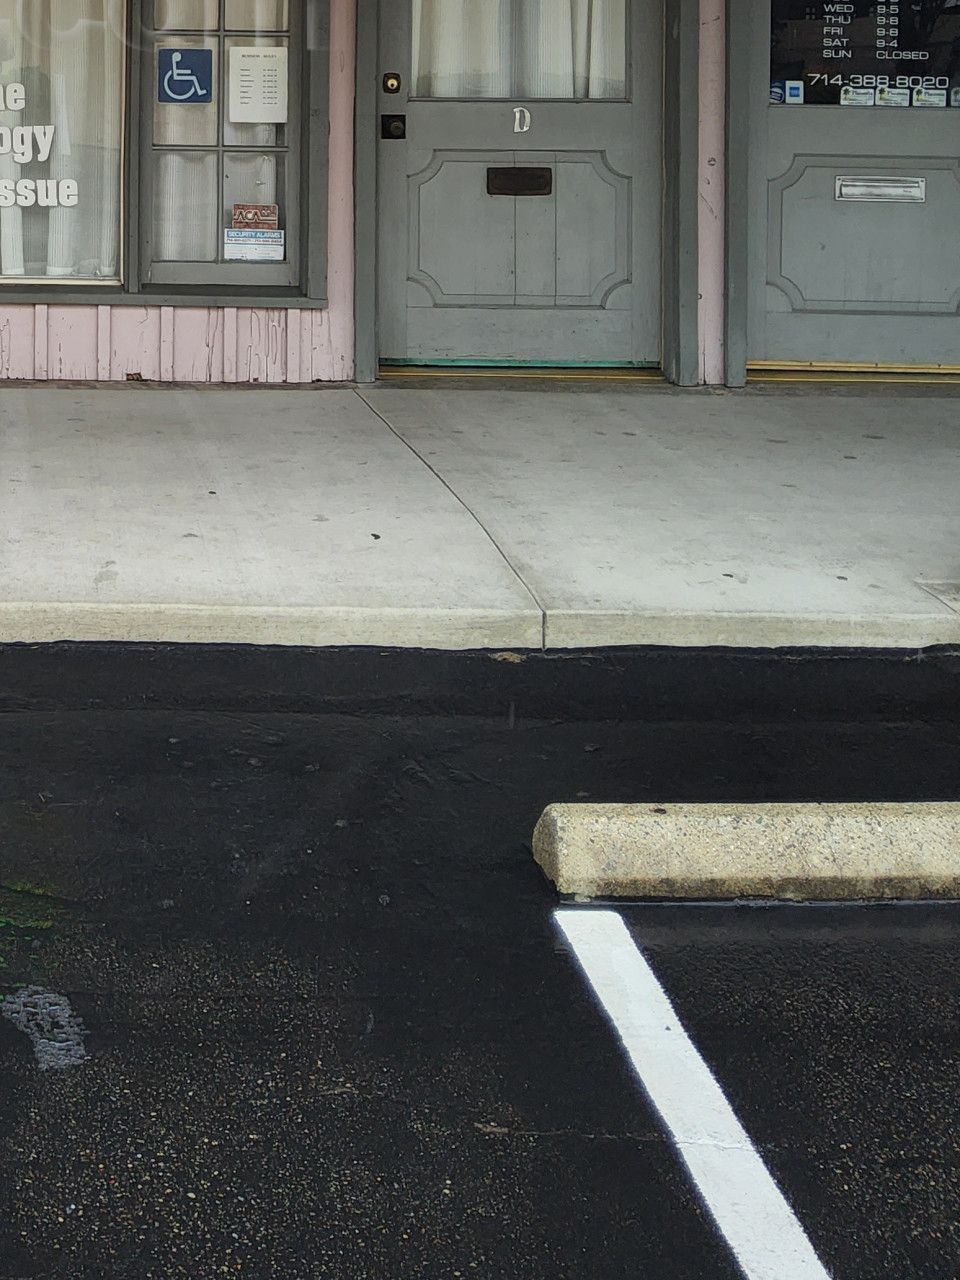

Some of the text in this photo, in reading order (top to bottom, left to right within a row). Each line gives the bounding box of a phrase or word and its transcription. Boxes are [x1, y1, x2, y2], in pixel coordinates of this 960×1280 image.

[823, 4, 854, 13] WED
[823, 15, 851, 24] THU
[823, 26, 843, 35] FRI
[823, 38, 850, 47] SAT
[822, 50, 930, 60] SUN CLOSED
[807, 73, 949, 89] 714-388-8020
[513, 107, 531, 133] D
